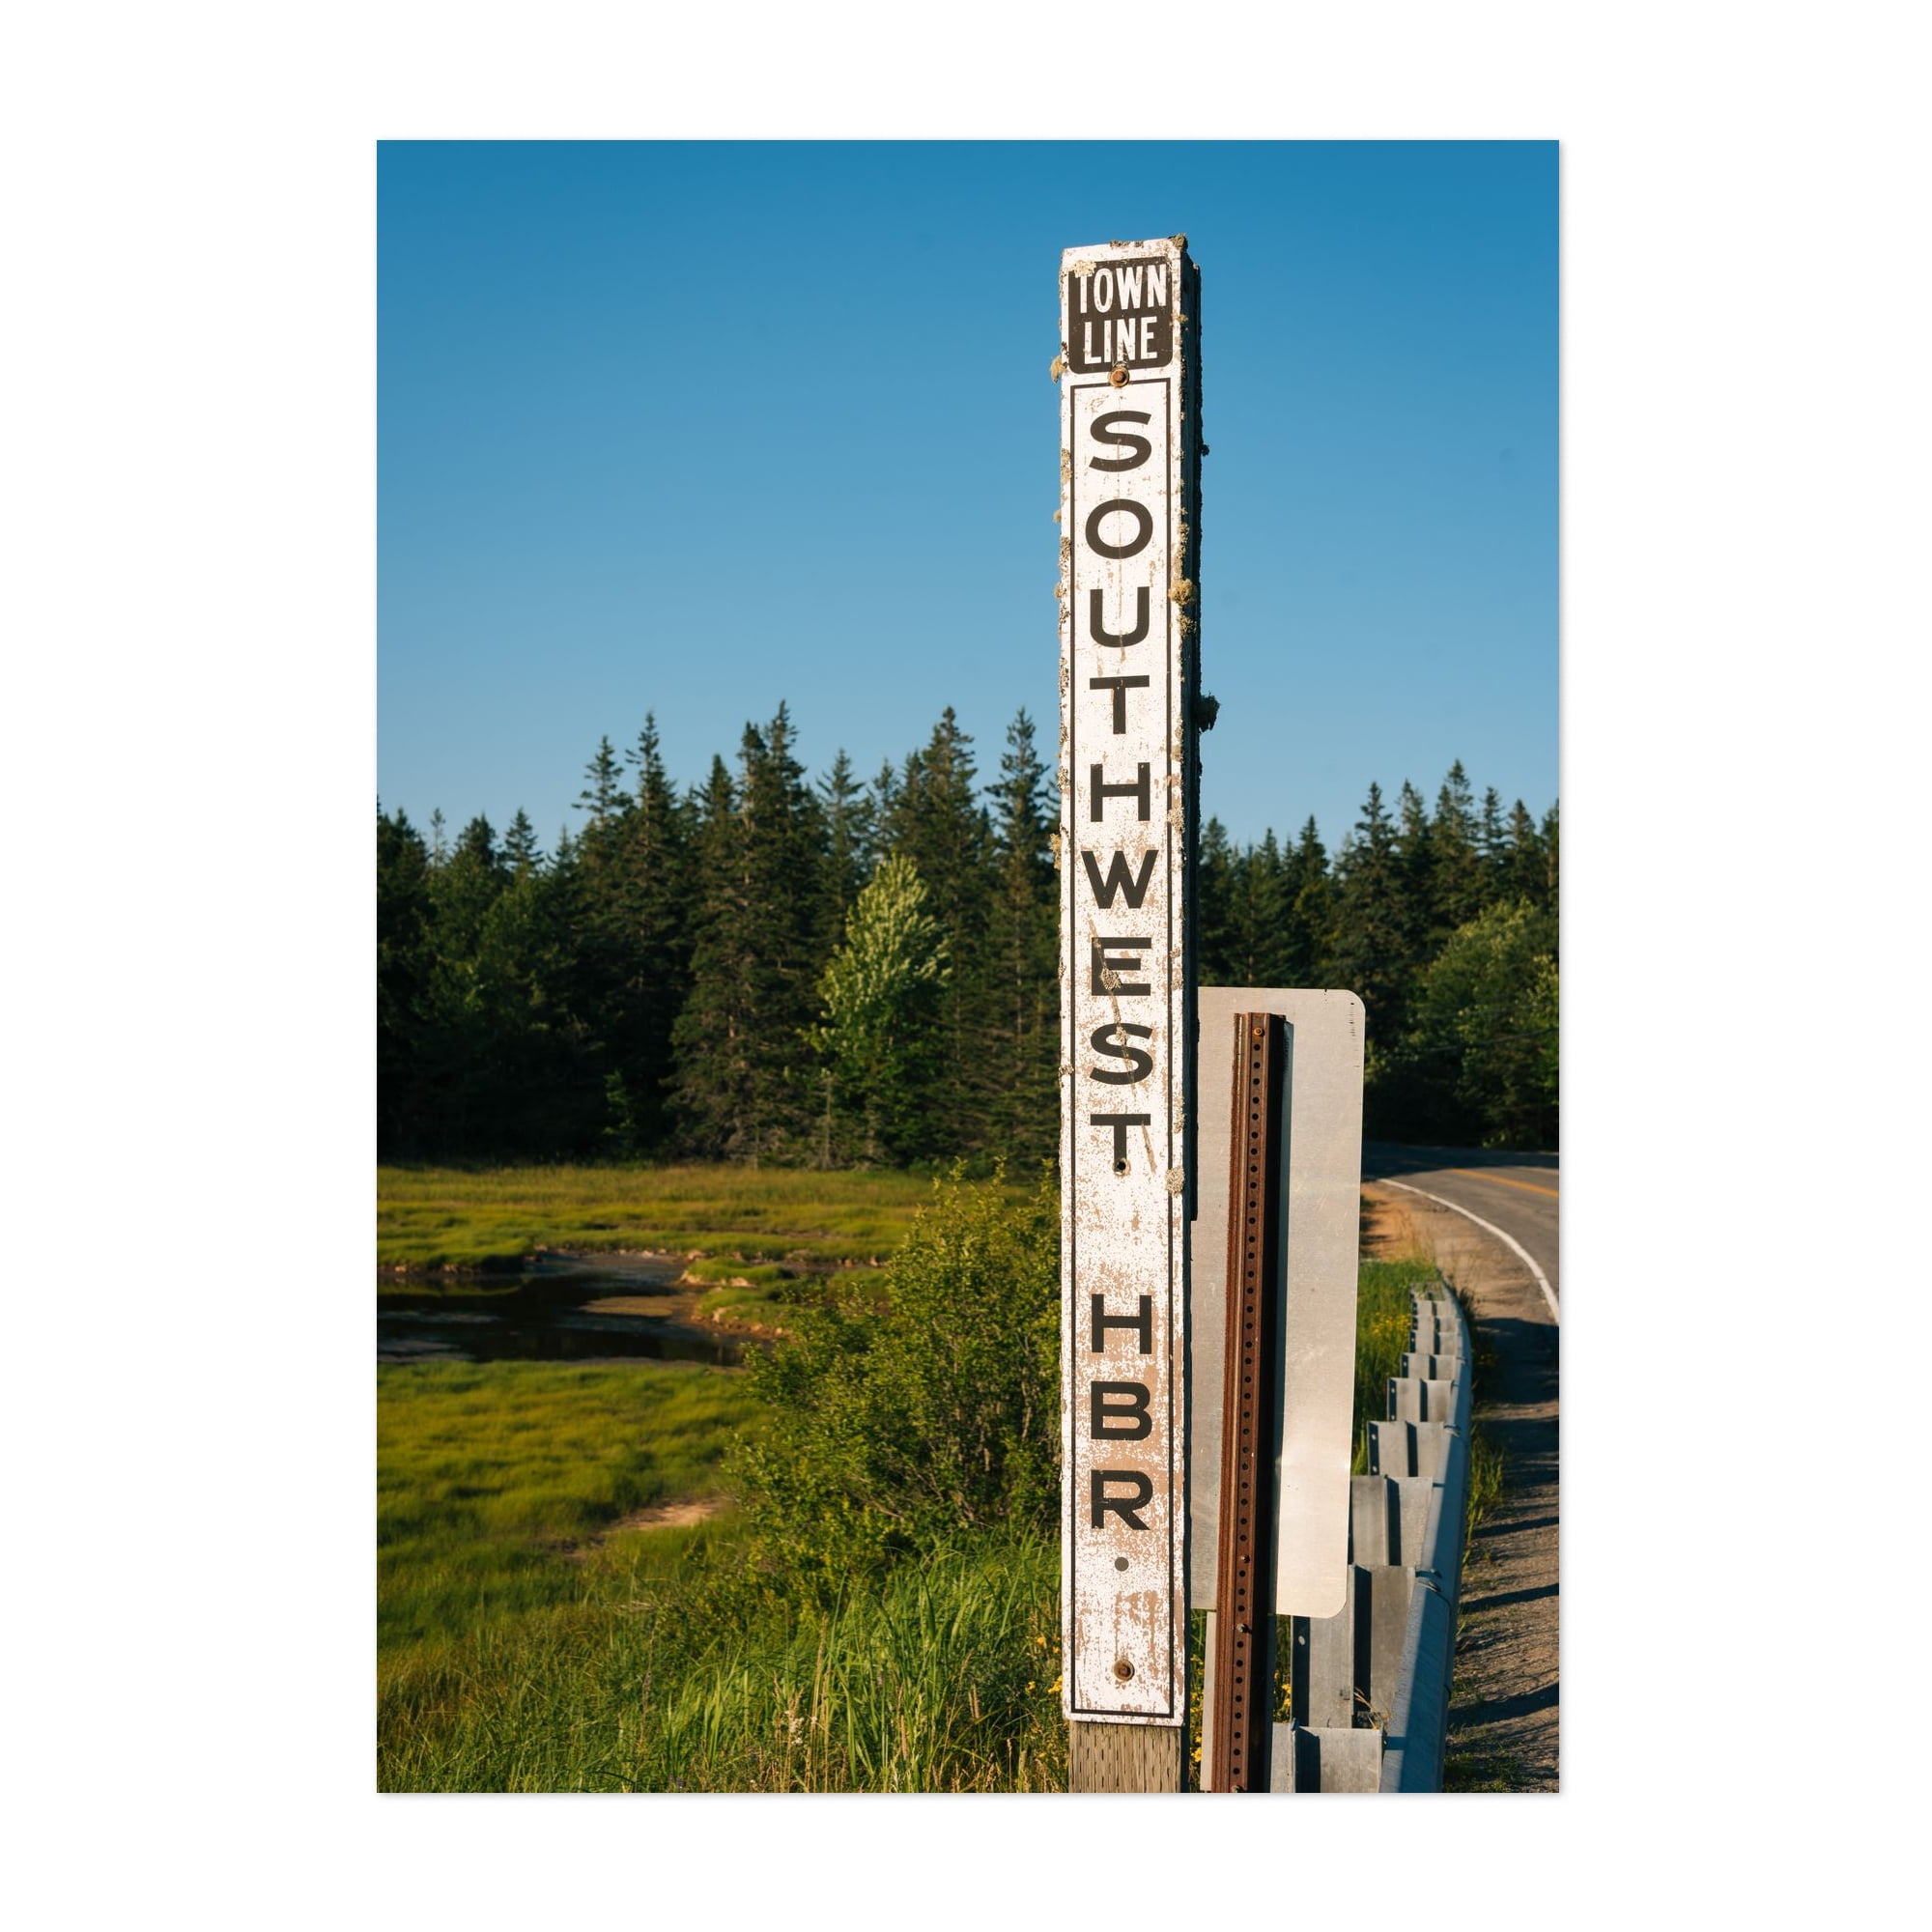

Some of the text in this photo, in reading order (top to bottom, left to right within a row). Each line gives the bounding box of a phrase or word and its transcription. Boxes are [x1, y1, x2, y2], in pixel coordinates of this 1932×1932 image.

[1075, 264, 1167, 314] TOWN
[1084, 316, 1158, 365] LINE
[1080, 410, 1159, 1162] SOUTHWEST
